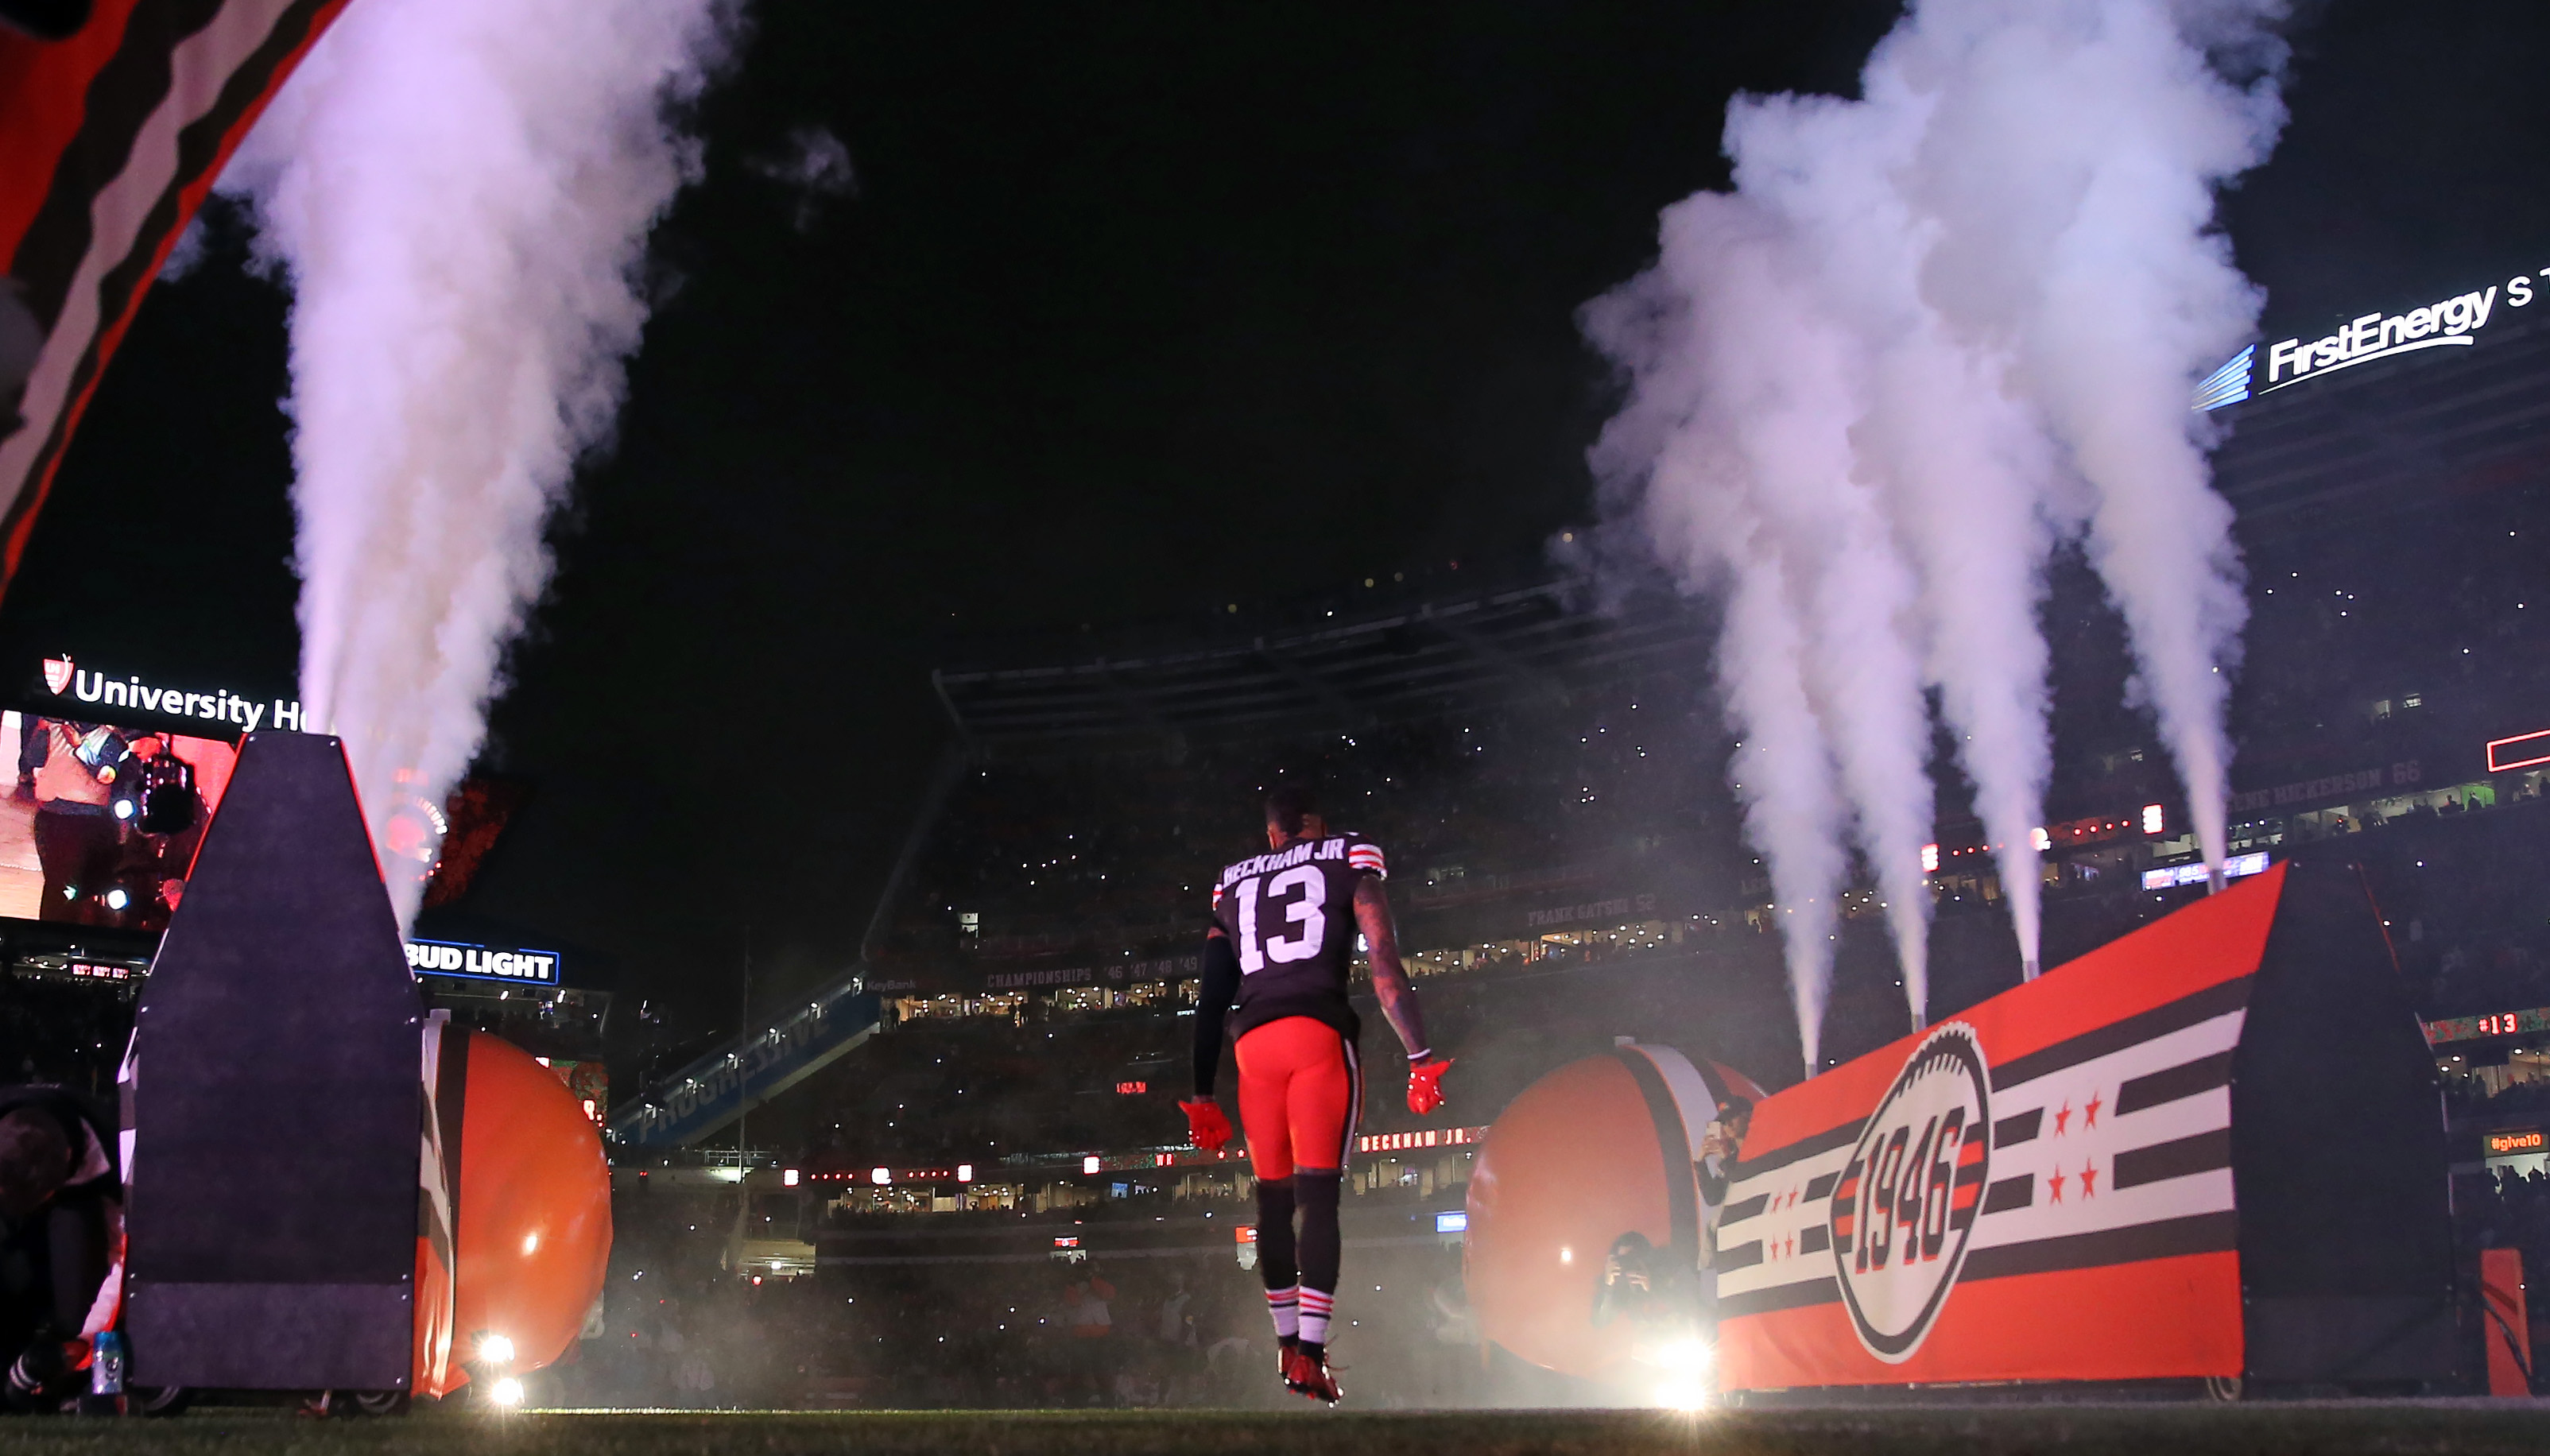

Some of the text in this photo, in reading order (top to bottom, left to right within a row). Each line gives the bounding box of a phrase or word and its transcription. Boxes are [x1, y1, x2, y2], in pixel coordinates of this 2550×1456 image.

[2268, 285, 2498, 383] FirstEnergy
[75, 669, 265, 732] University
[1313, 838, 1345, 861] JR
[1234, 864, 1327, 976] 13
[403, 943, 554, 979] BUD LIGHT
[866, 979, 916, 992] KeyBank
[987, 967, 1091, 988] CHAMPIONSHIPS
[1360, 1127, 1471, 1153] BECKHAM JR.
[2490, 1133, 2543, 1152] #give10
[1854, 1105, 1965, 1275] 1946
